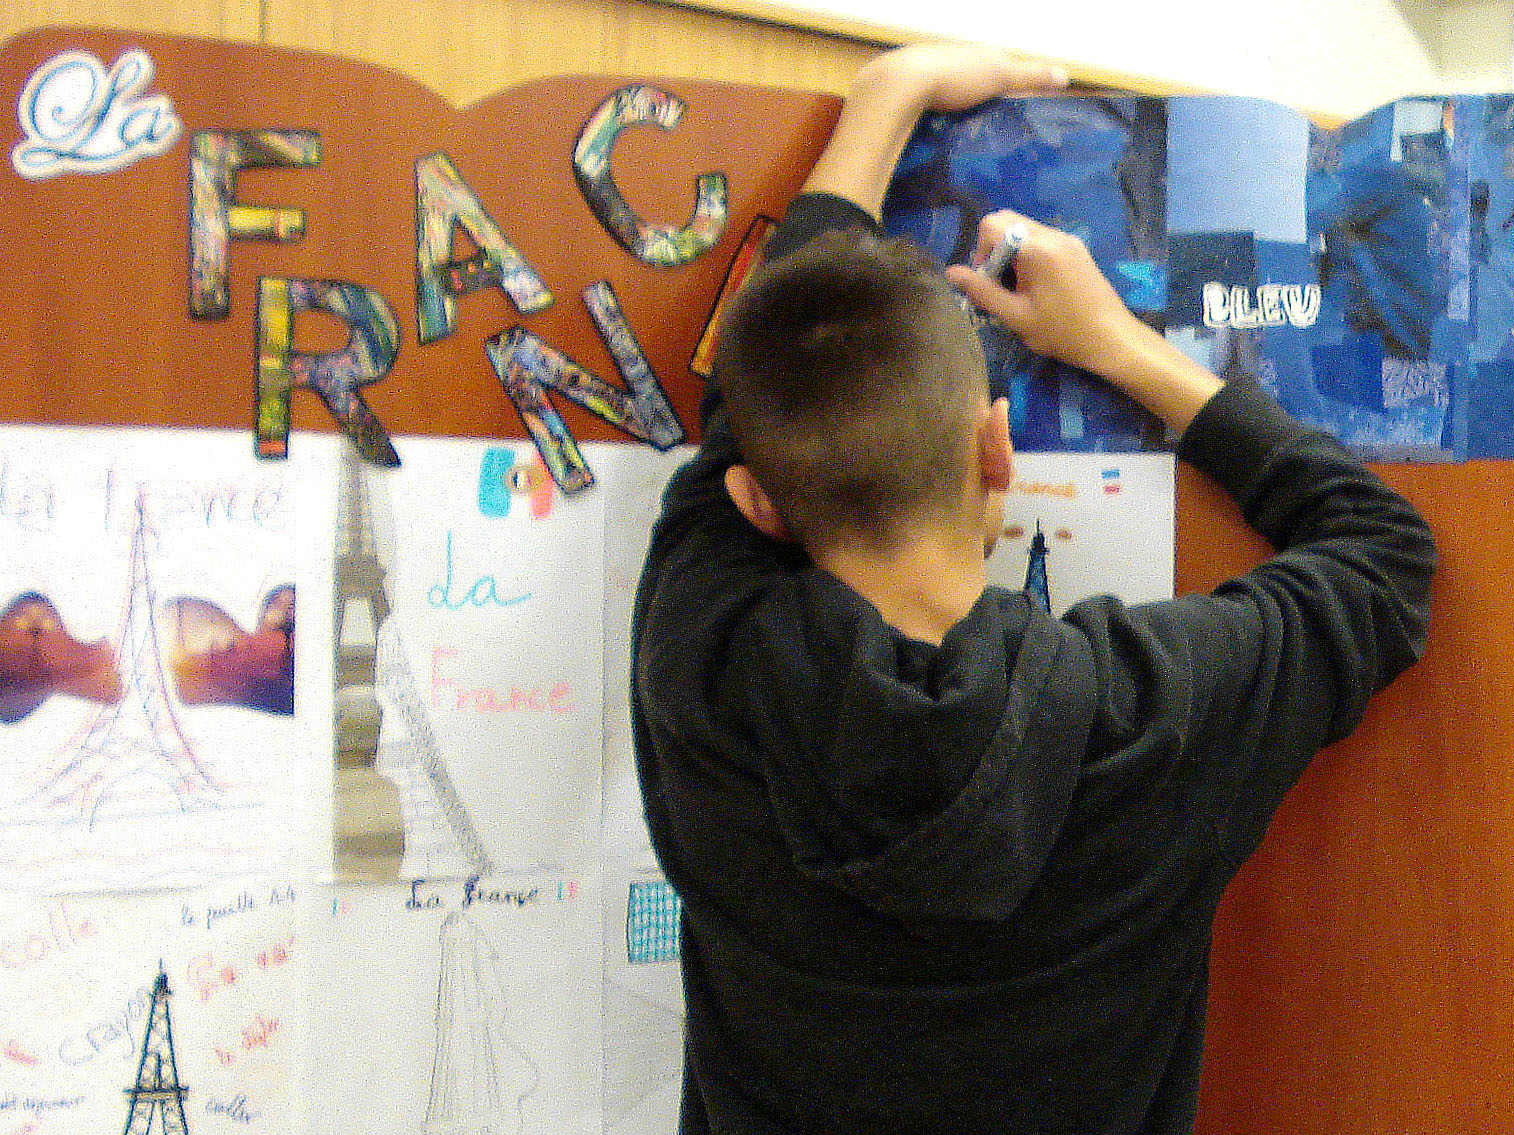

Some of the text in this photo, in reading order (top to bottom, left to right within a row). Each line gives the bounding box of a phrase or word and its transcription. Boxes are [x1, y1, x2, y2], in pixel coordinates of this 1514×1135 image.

[16, 53, 180, 175] La
[1202, 281, 1322, 330] BLEU
[427, 529, 534, 611] La
[430, 645, 577, 716] France
